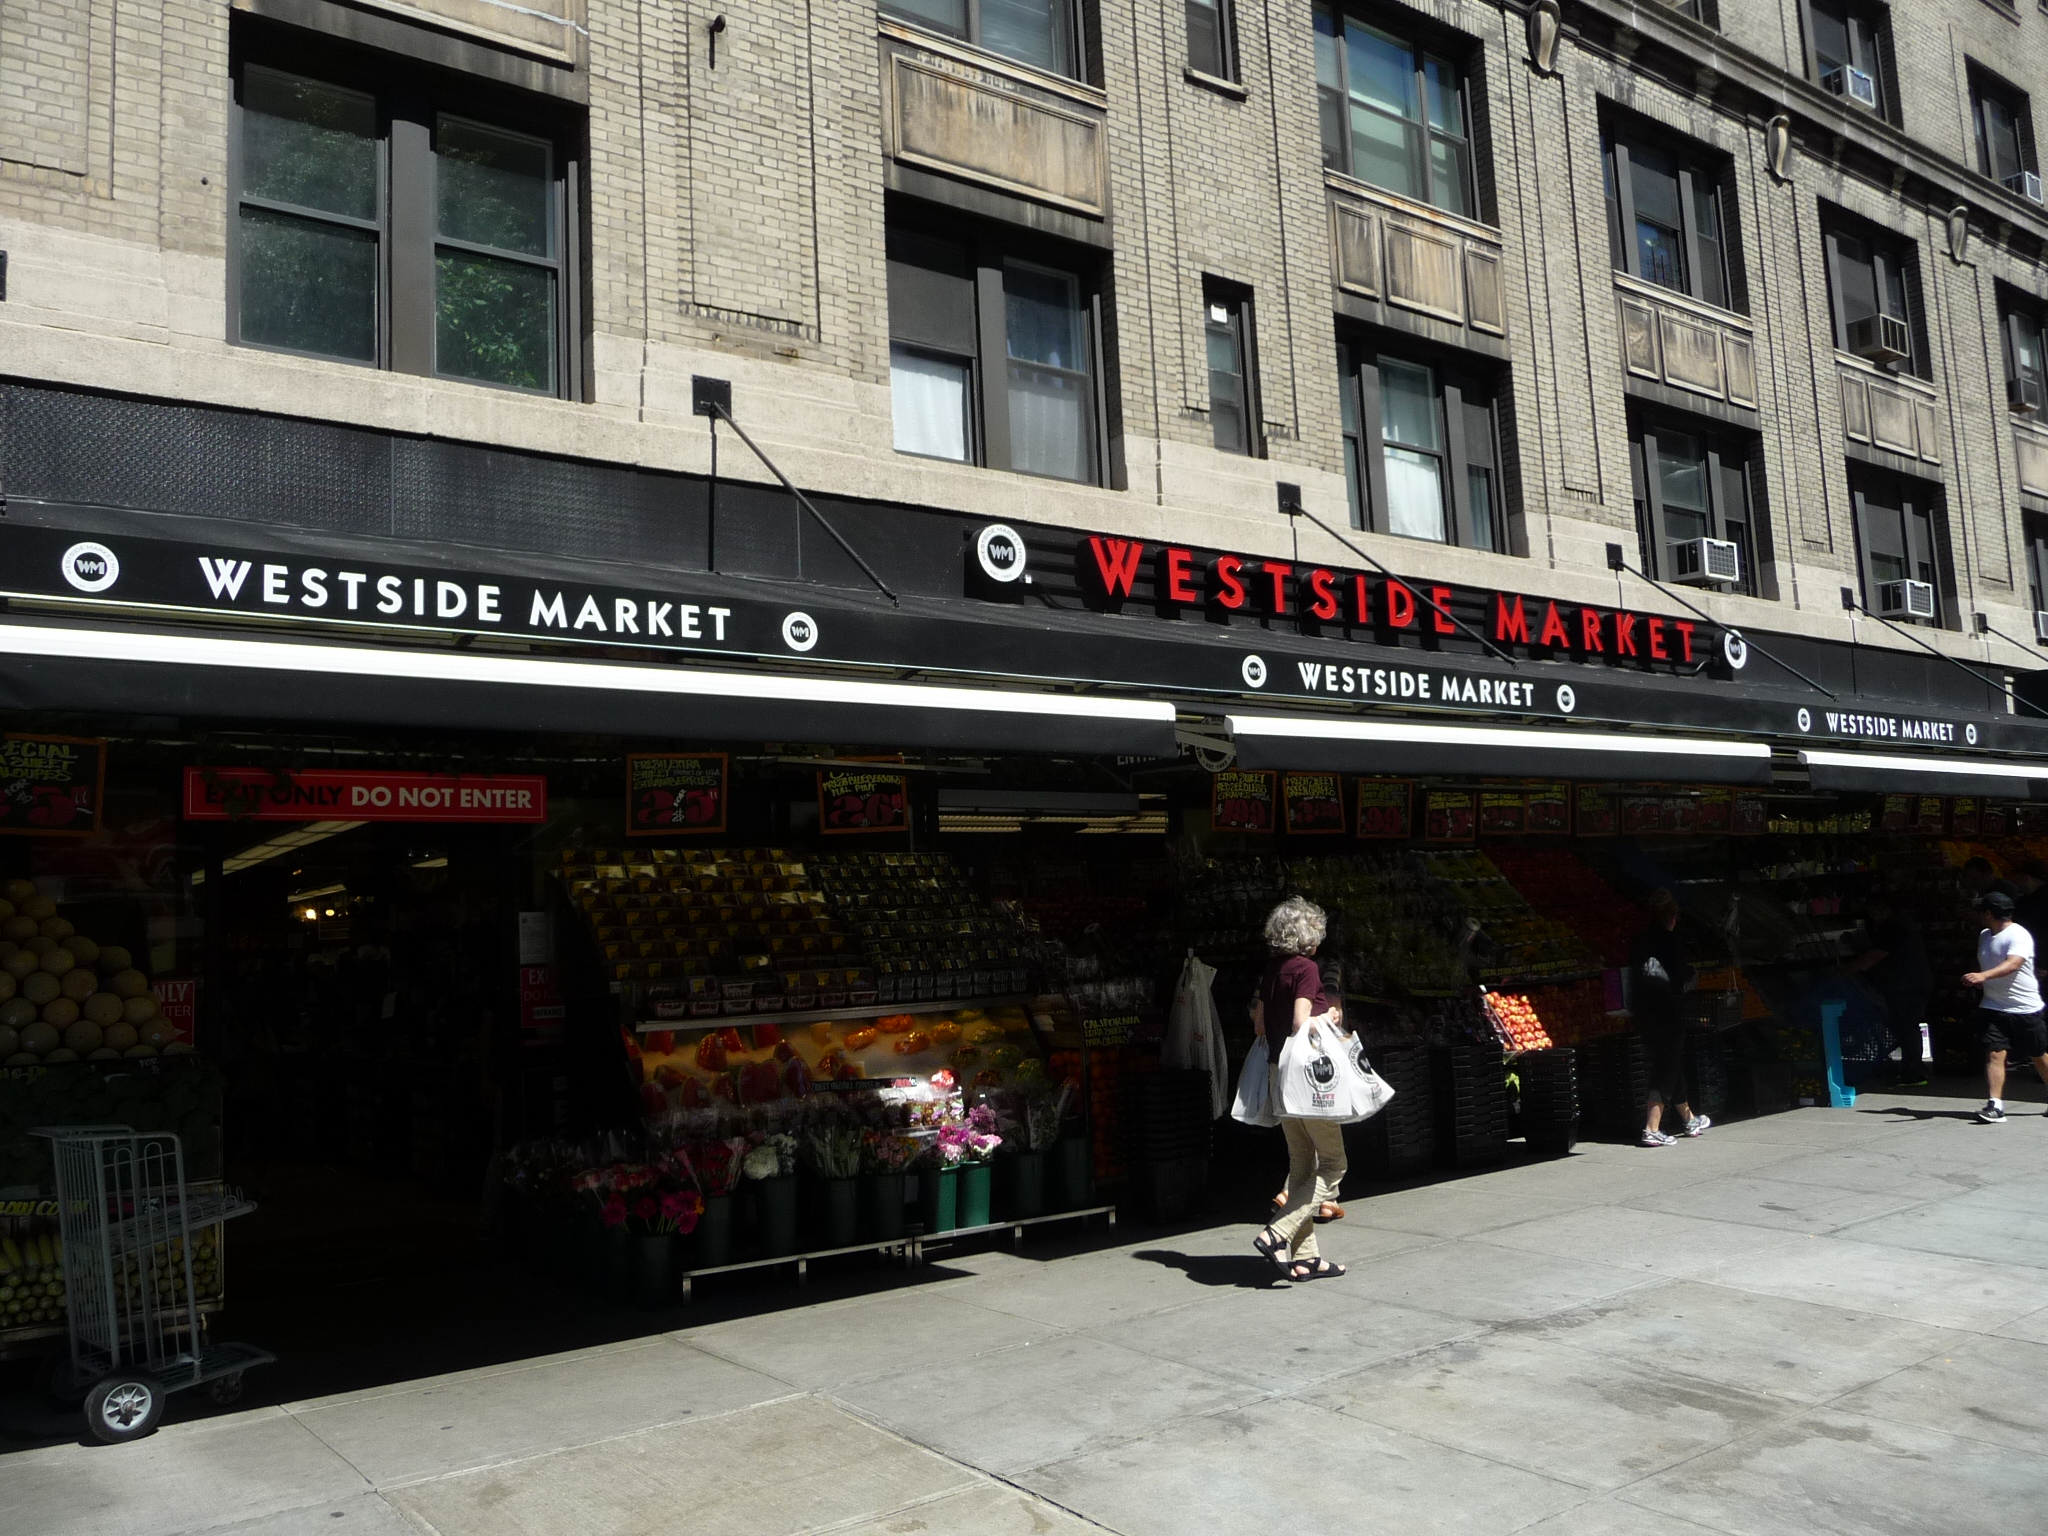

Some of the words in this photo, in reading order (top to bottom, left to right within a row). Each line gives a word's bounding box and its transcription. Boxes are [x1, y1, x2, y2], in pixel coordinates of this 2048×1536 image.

[989, 544, 1014, 561] WM
[76, 559, 105, 575] WM
[198, 557, 502, 623] WESTSIDE
[529, 589, 731, 641] MARKET
[1089, 536, 1456, 634] WESTSIDE
[1496, 593, 1695, 663] MARKET
[791, 625, 810, 638] WM
[1297, 661, 1431, 699] WESTSIDE
[1441, 675, 1534, 707] MARKET
[1825, 712, 1898, 738] WESTSIDE
[1902, 719, 1954, 741] MARKET
[0, 740, 78, 759] ECIAL
[633, 759, 667, 771] FRESH
[633, 775, 718, 790] STRAWBERRIES
[268, 780, 345, 806] ONLY
[351, 785, 393, 808] DO
[398, 786, 455, 809] NOT
[459, 788, 533, 809] ENTER
[153, 983, 188, 1003] NLY
[160, 1004, 191, 1017] TER
[1083, 1015, 1140, 1030] CALIFORNIA
[1313, 1063, 1333, 1076] WM
